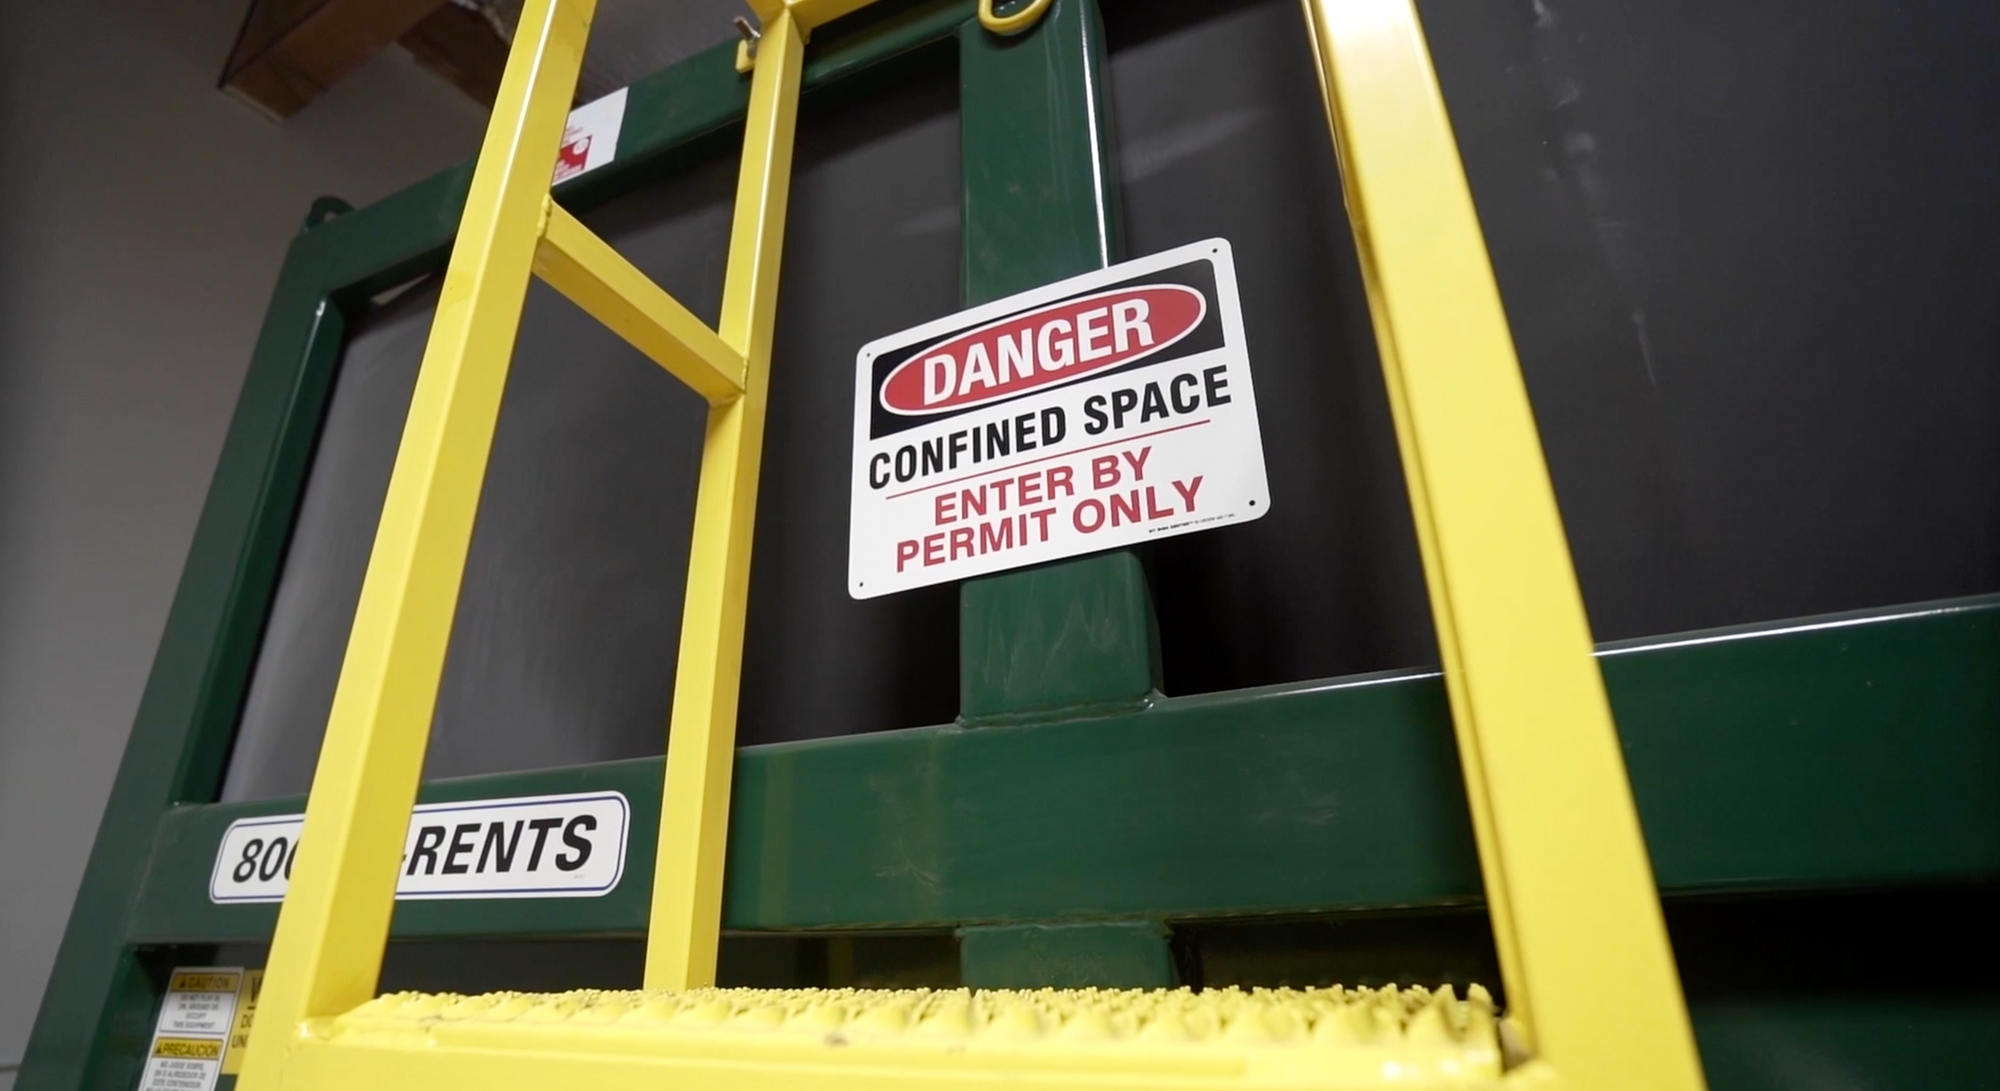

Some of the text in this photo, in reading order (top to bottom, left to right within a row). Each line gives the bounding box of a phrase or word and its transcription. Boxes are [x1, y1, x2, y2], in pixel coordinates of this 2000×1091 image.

[923, 298, 1155, 405] DANGER
[869, 364, 1232, 490] CONFINED SPACE
[896, 475, 1204, 573] PERMIT ONLY
[935, 446, 1153, 526] ENTER BY
[188, 976, 230, 989] CAUTION
